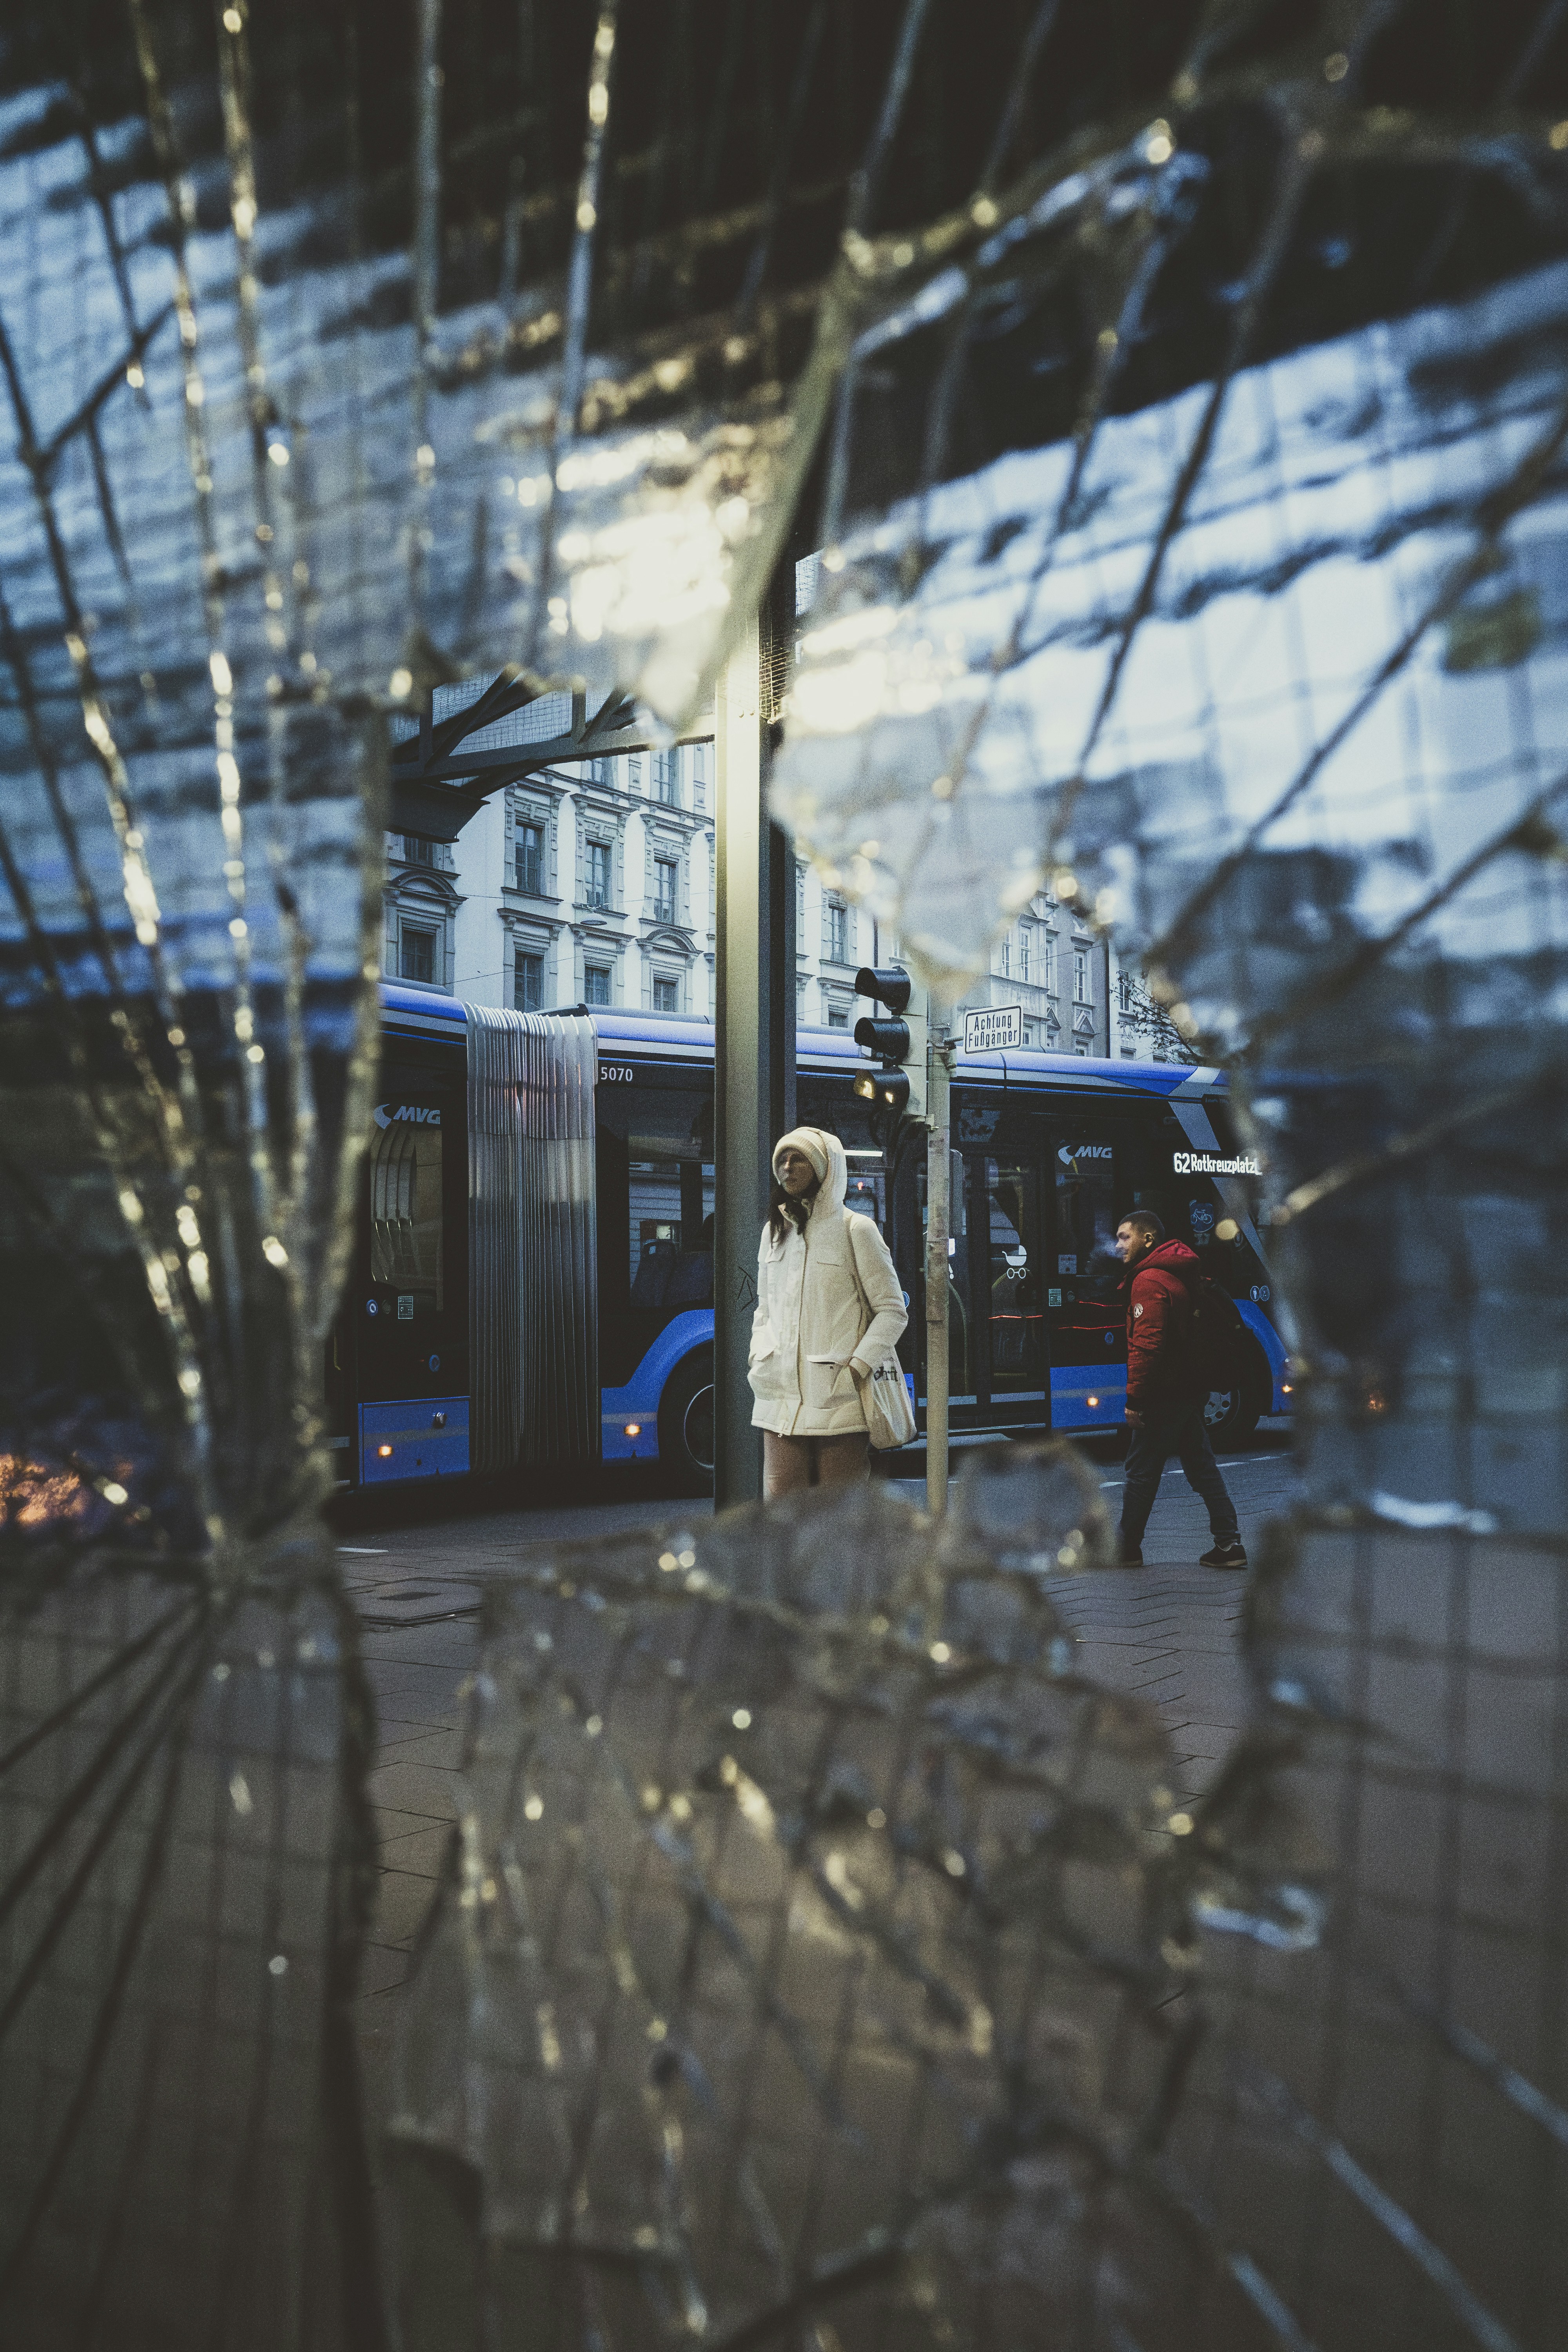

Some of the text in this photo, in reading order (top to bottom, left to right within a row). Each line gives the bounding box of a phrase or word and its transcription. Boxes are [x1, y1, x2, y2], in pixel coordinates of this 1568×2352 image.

[974, 1014, 1011, 1031] Achtung
[969, 1029, 1017, 1047] Fußgänger
[601, 1067, 633, 1082] 5070
[393, 1106, 441, 1124] MVG
[1074, 1146, 1112, 1158] MVG
[1174, 1152, 1191, 1173] 62
[1191, 1154, 1255, 1174] Rotkreuzplatz
